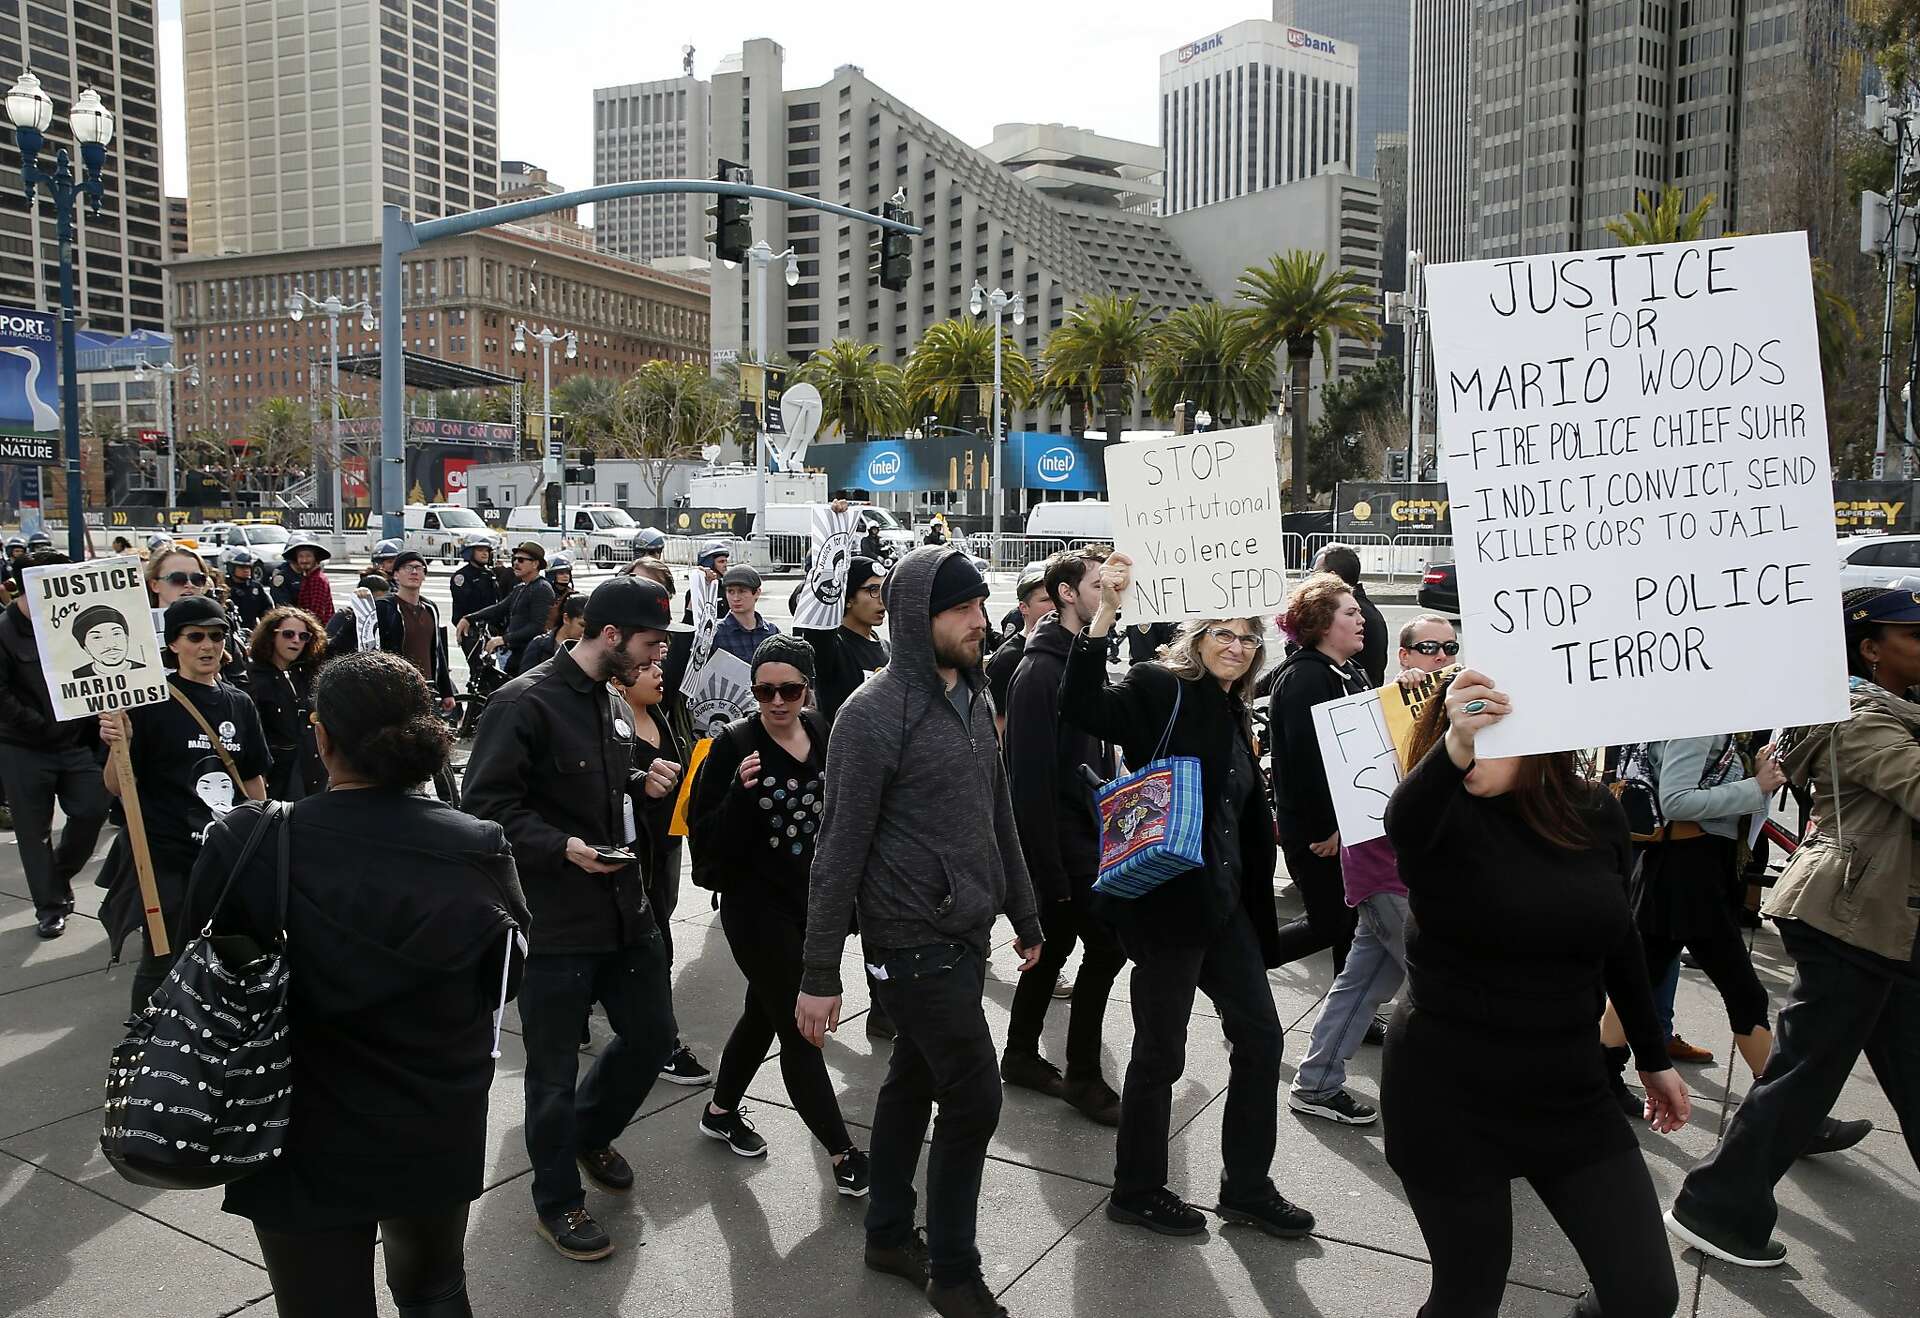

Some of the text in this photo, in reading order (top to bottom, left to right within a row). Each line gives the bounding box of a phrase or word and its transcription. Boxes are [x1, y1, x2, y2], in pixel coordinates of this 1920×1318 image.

[1489, 246, 1738, 317] JUSTICE
[0, 315, 44, 335] PORT
[9, 331, 52, 342] FRANCISCO
[1585, 308, 1657, 351] FOR
[1450, 339, 1786, 413] MARIO WOODS
[441, 422, 462, 435] CNN
[468, 424, 488, 437] CNN
[492, 427, 513, 439] CNN
[1550, 416, 1641, 461] POLICE
[1653, 406, 1732, 448] CHIEF
[1738, 403, 1806, 440] SUHR
[0, 444, 53, 459] NATURE
[1043, 456, 1069, 472] intel
[1142, 440, 1236, 486] STOP
[871, 458, 896, 475] intel
[1748, 456, 1816, 490] SEND
[300, 512, 333, 528] ENTRANCE
[701, 511, 736, 529] CITY
[1125, 487, 1271, 528] Institutional
[1391, 499, 1449, 521] CITY
[1834, 500, 1904, 525] CITY
[1476, 504, 1799, 563] KILLER COPS TO JAIL
[1145, 536, 1259, 566] Violence
[42, 567, 141, 600] JUSTICE
[1134, 567, 1285, 616] NFL SFPD
[1491, 563, 1813, 633] STOP POLICE
[50, 601, 80, 629] for
[1551, 626, 1713, 685] TERROR
[61, 674, 127, 699] MARIO
[86, 684, 167, 713] WOODS!
[694, 702, 715, 718] Justice
